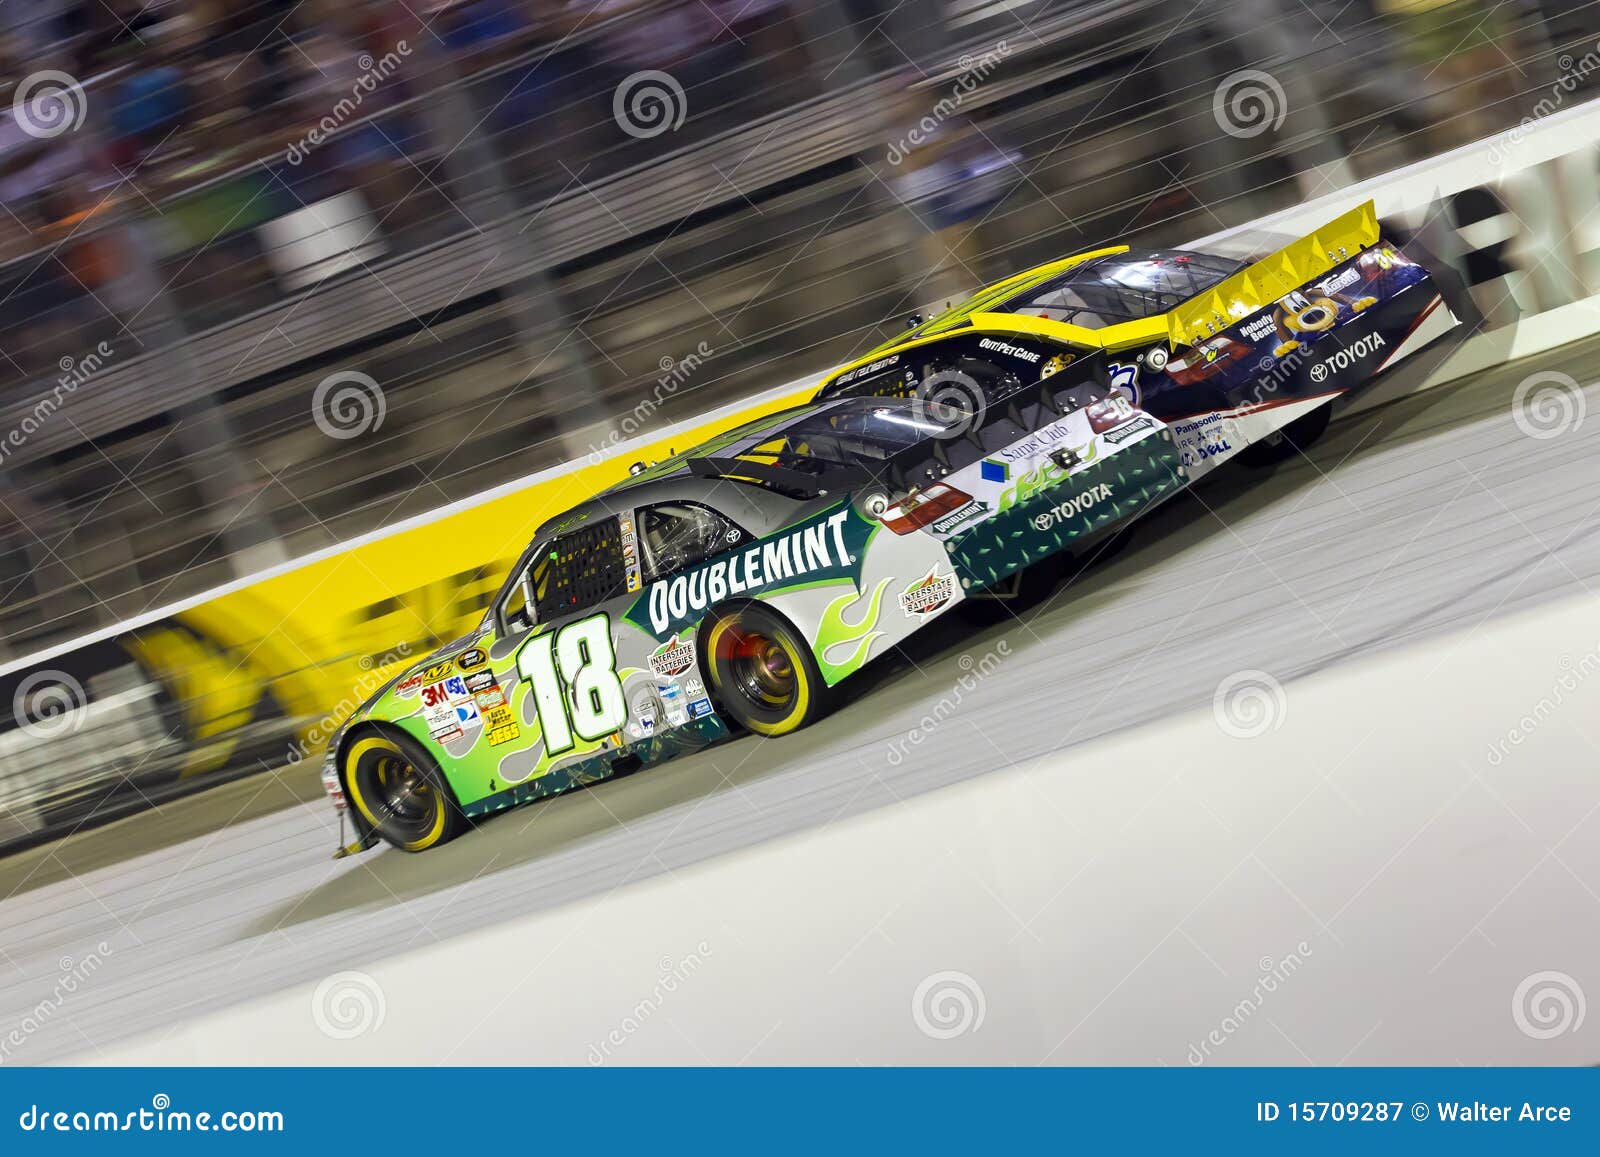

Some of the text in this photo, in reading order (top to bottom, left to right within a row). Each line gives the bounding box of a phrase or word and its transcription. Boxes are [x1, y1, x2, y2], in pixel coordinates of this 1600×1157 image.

[1240, 314, 1274, 337] Nobody
[1250, 323, 1278, 342] Beats
[1325, 331, 1386, 374] TOYOTA
[1036, 424, 1069, 445] Club
[1174, 412, 1222, 436] Panasonic
[1197, 439, 1231, 460] DELL
[1050, 482, 1113, 521] TOYOTA
[934, 502, 985, 533] DOUBLEMINT
[648, 509, 853, 635] DOUBLEMINT
[902, 578, 952, 604] INTERSTATE
[907, 588, 952, 612] BATTERIES
[650, 644, 693, 666] INTERSTATE
[656, 654, 694, 674] BATTERIES
[421, 682, 449, 707] 3M
[517, 612, 627, 758] 18
